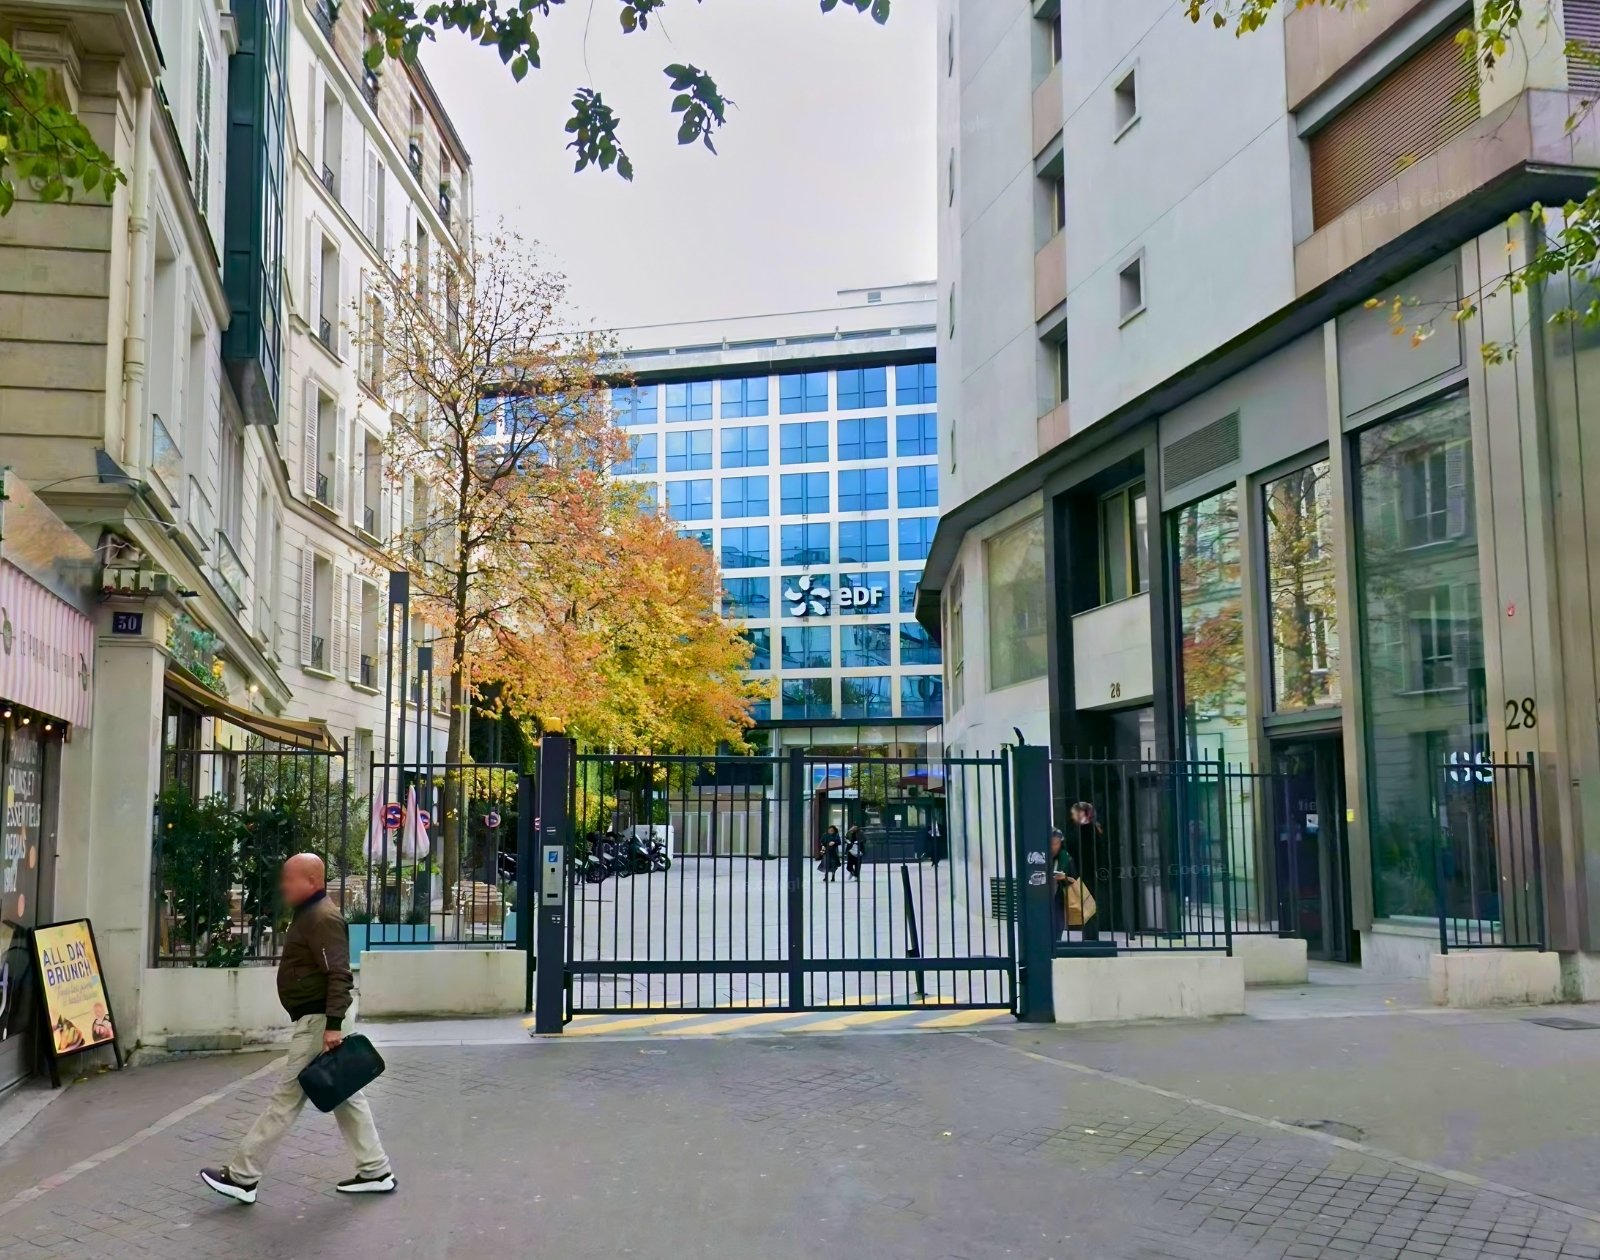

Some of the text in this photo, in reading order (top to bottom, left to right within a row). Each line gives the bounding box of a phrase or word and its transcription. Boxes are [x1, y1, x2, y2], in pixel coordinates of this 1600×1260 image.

[118, 615, 137, 630] 30
[1110, 682, 1121, 699] 28
[1505, 697, 1537, 730] 28
[43, 940, 87, 967] ALL DAY
[47, 962, 92, 986] BRUNCH
